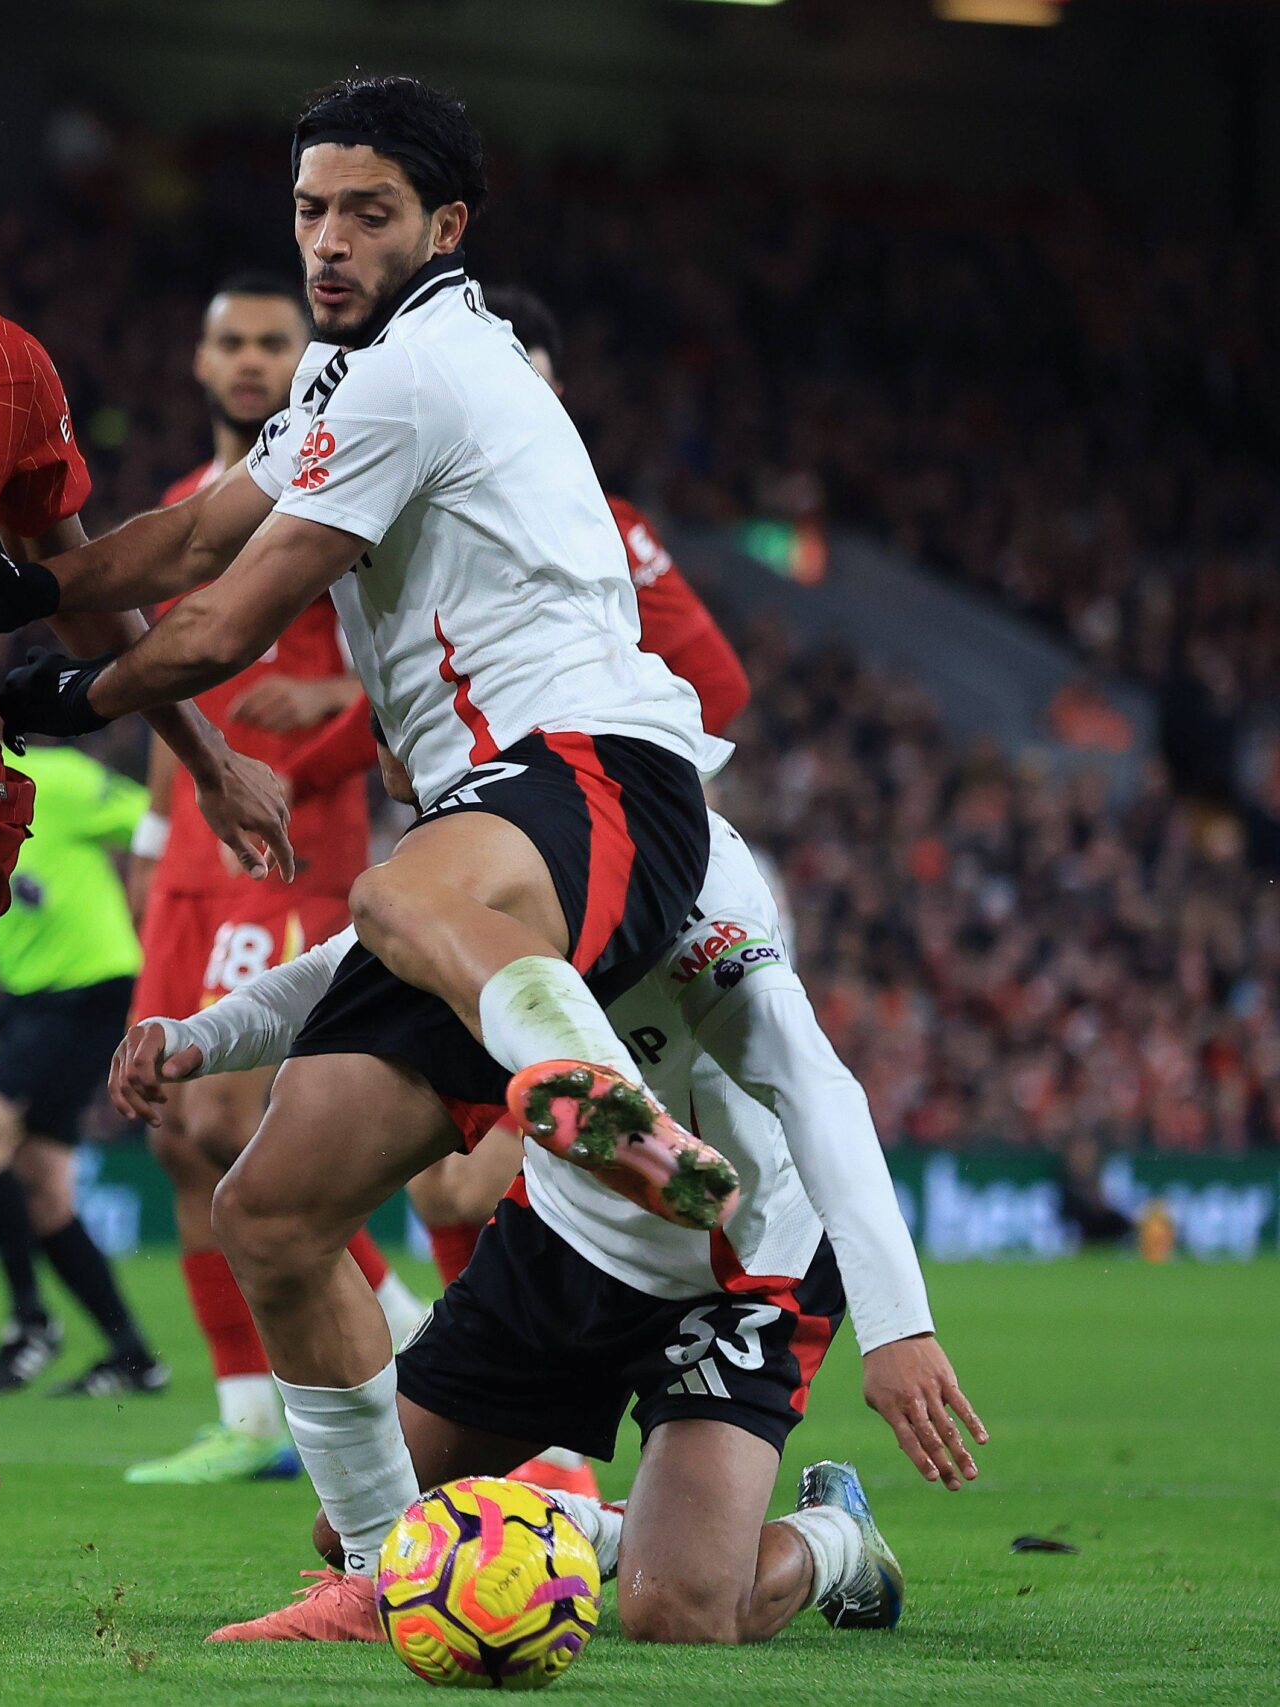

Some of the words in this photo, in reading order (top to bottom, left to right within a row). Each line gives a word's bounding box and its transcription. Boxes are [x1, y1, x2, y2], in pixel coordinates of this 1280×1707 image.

[299, 420, 336, 459] eb
[202, 920, 275, 992] 18
[671, 920, 748, 985] Web
